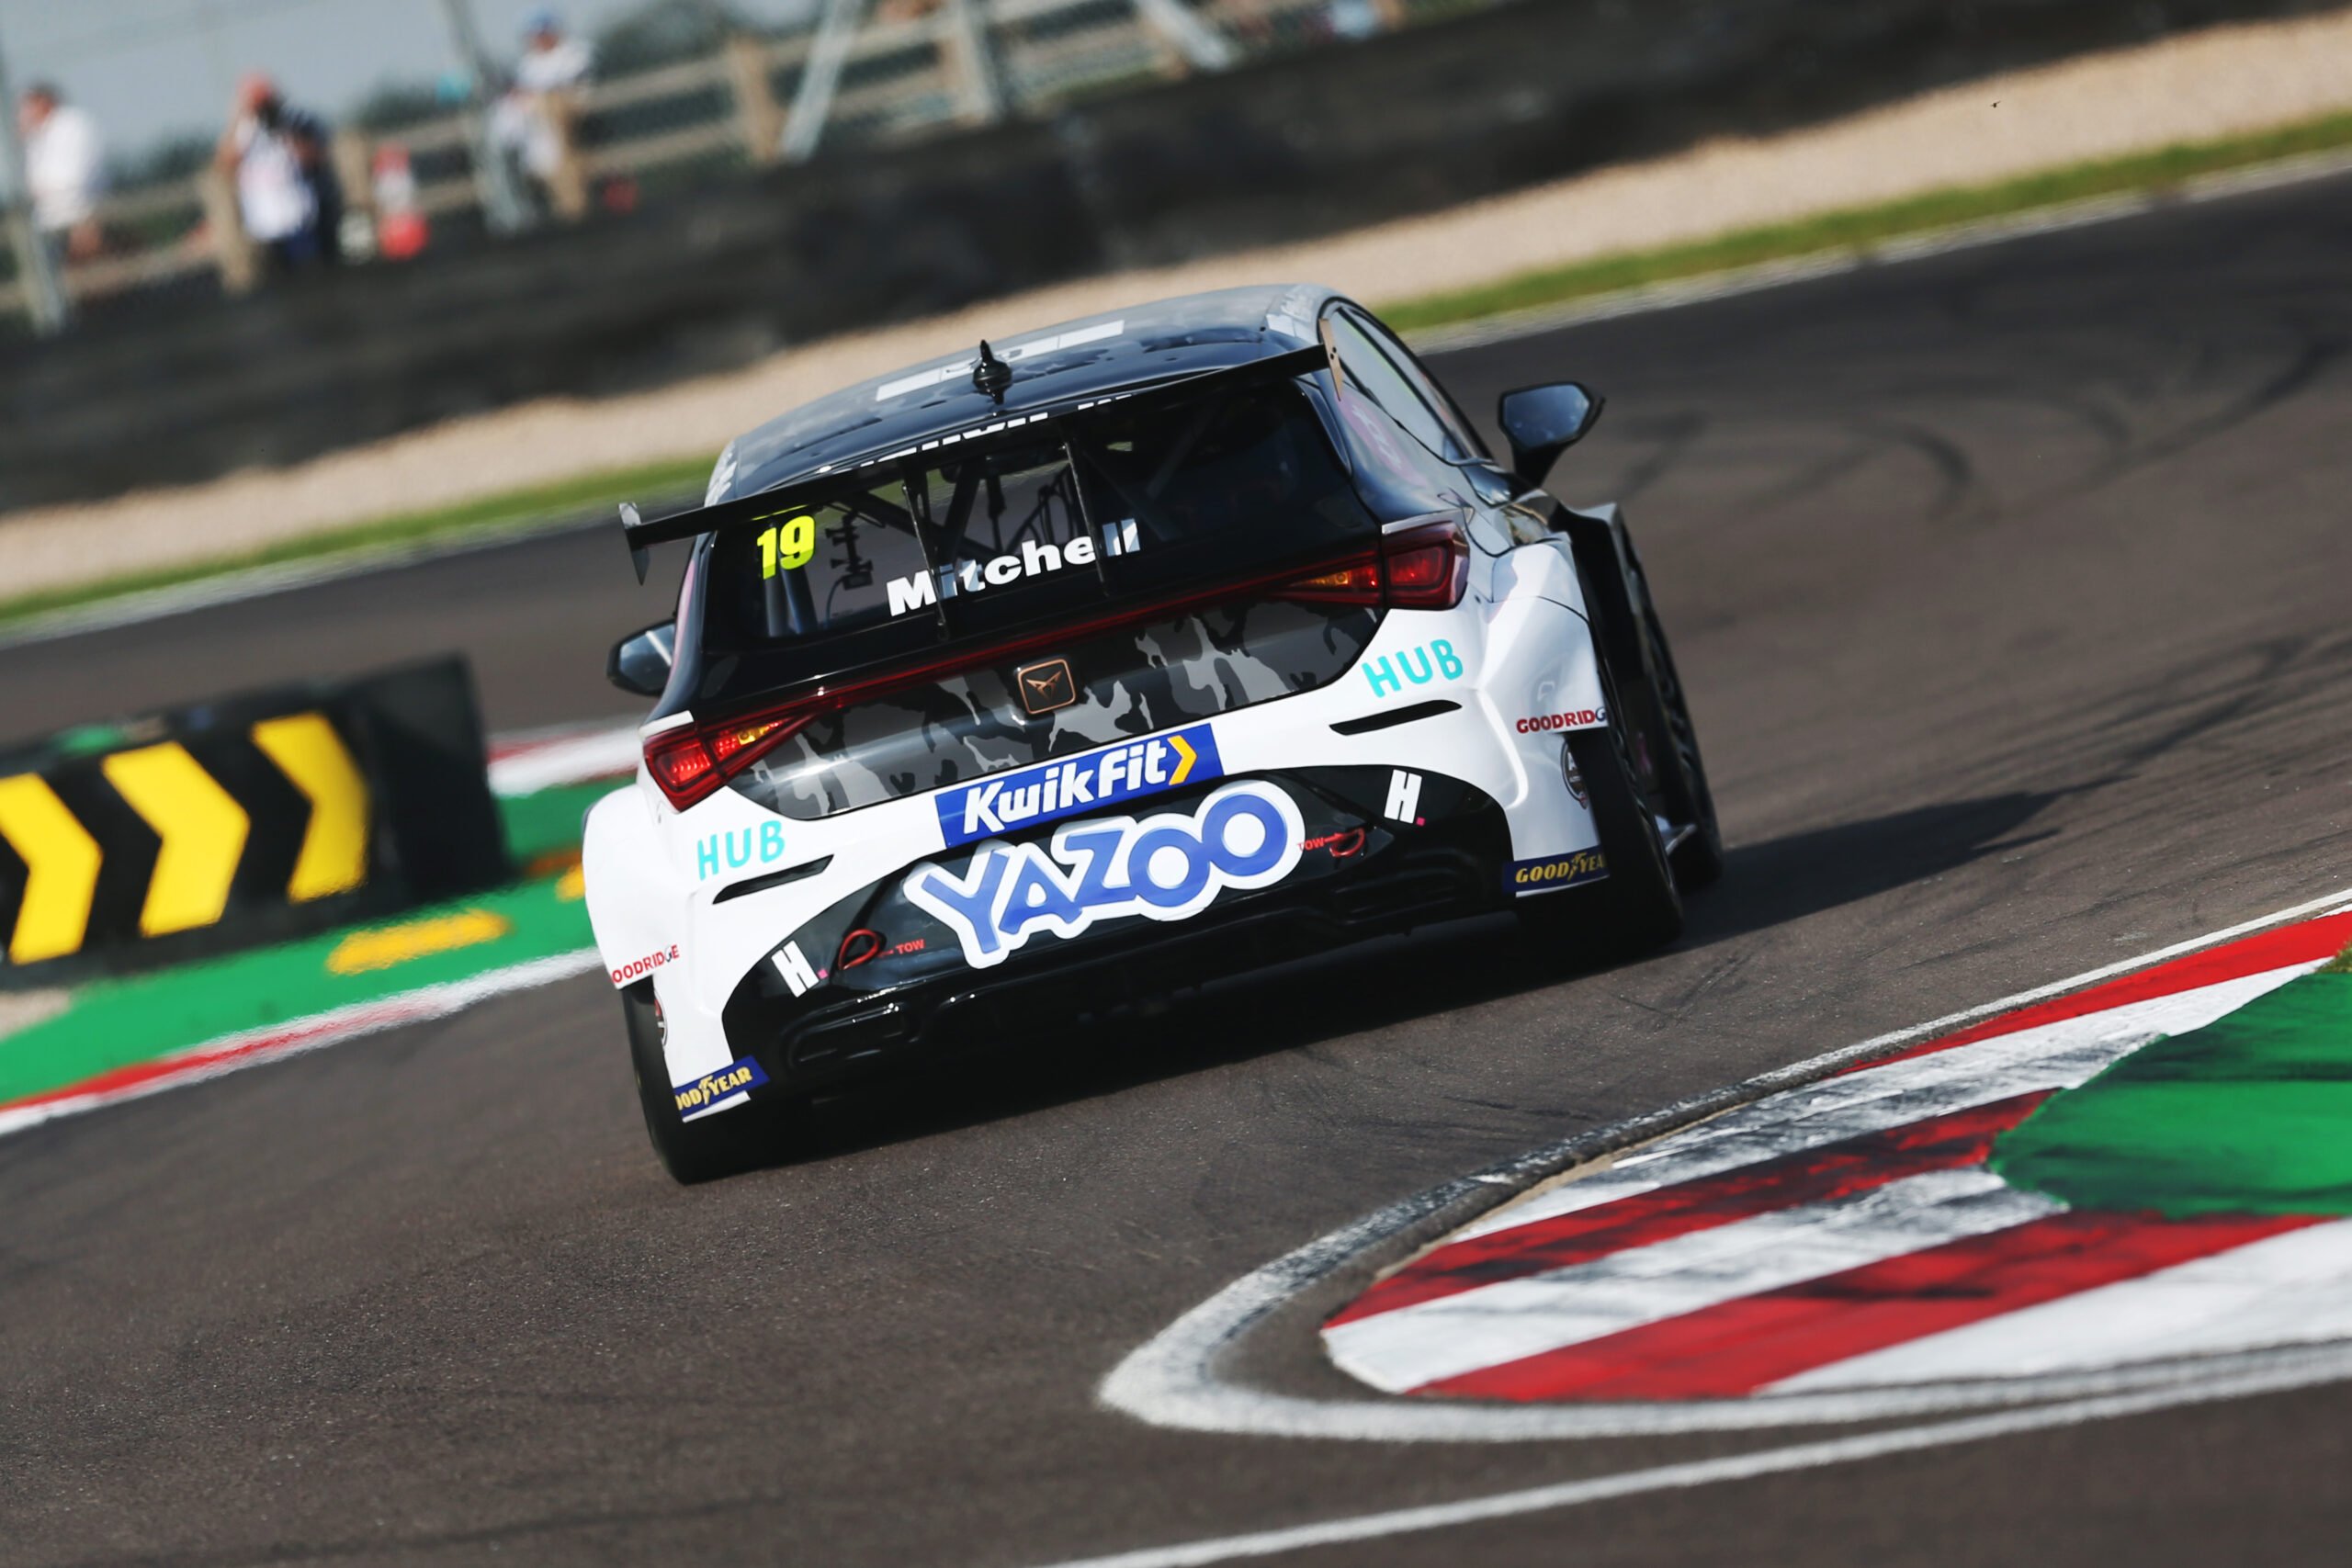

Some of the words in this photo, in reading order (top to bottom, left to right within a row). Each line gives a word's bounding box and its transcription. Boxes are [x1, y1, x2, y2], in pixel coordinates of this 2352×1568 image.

[757, 514, 816, 580] 19
[886, 517, 1141, 617] Mitchell
[1362, 637, 1464, 698] HUB
[696, 819, 786, 881] HUB
[920, 793, 1289, 954] YAZOO
[895, 939, 925, 954] TOW
